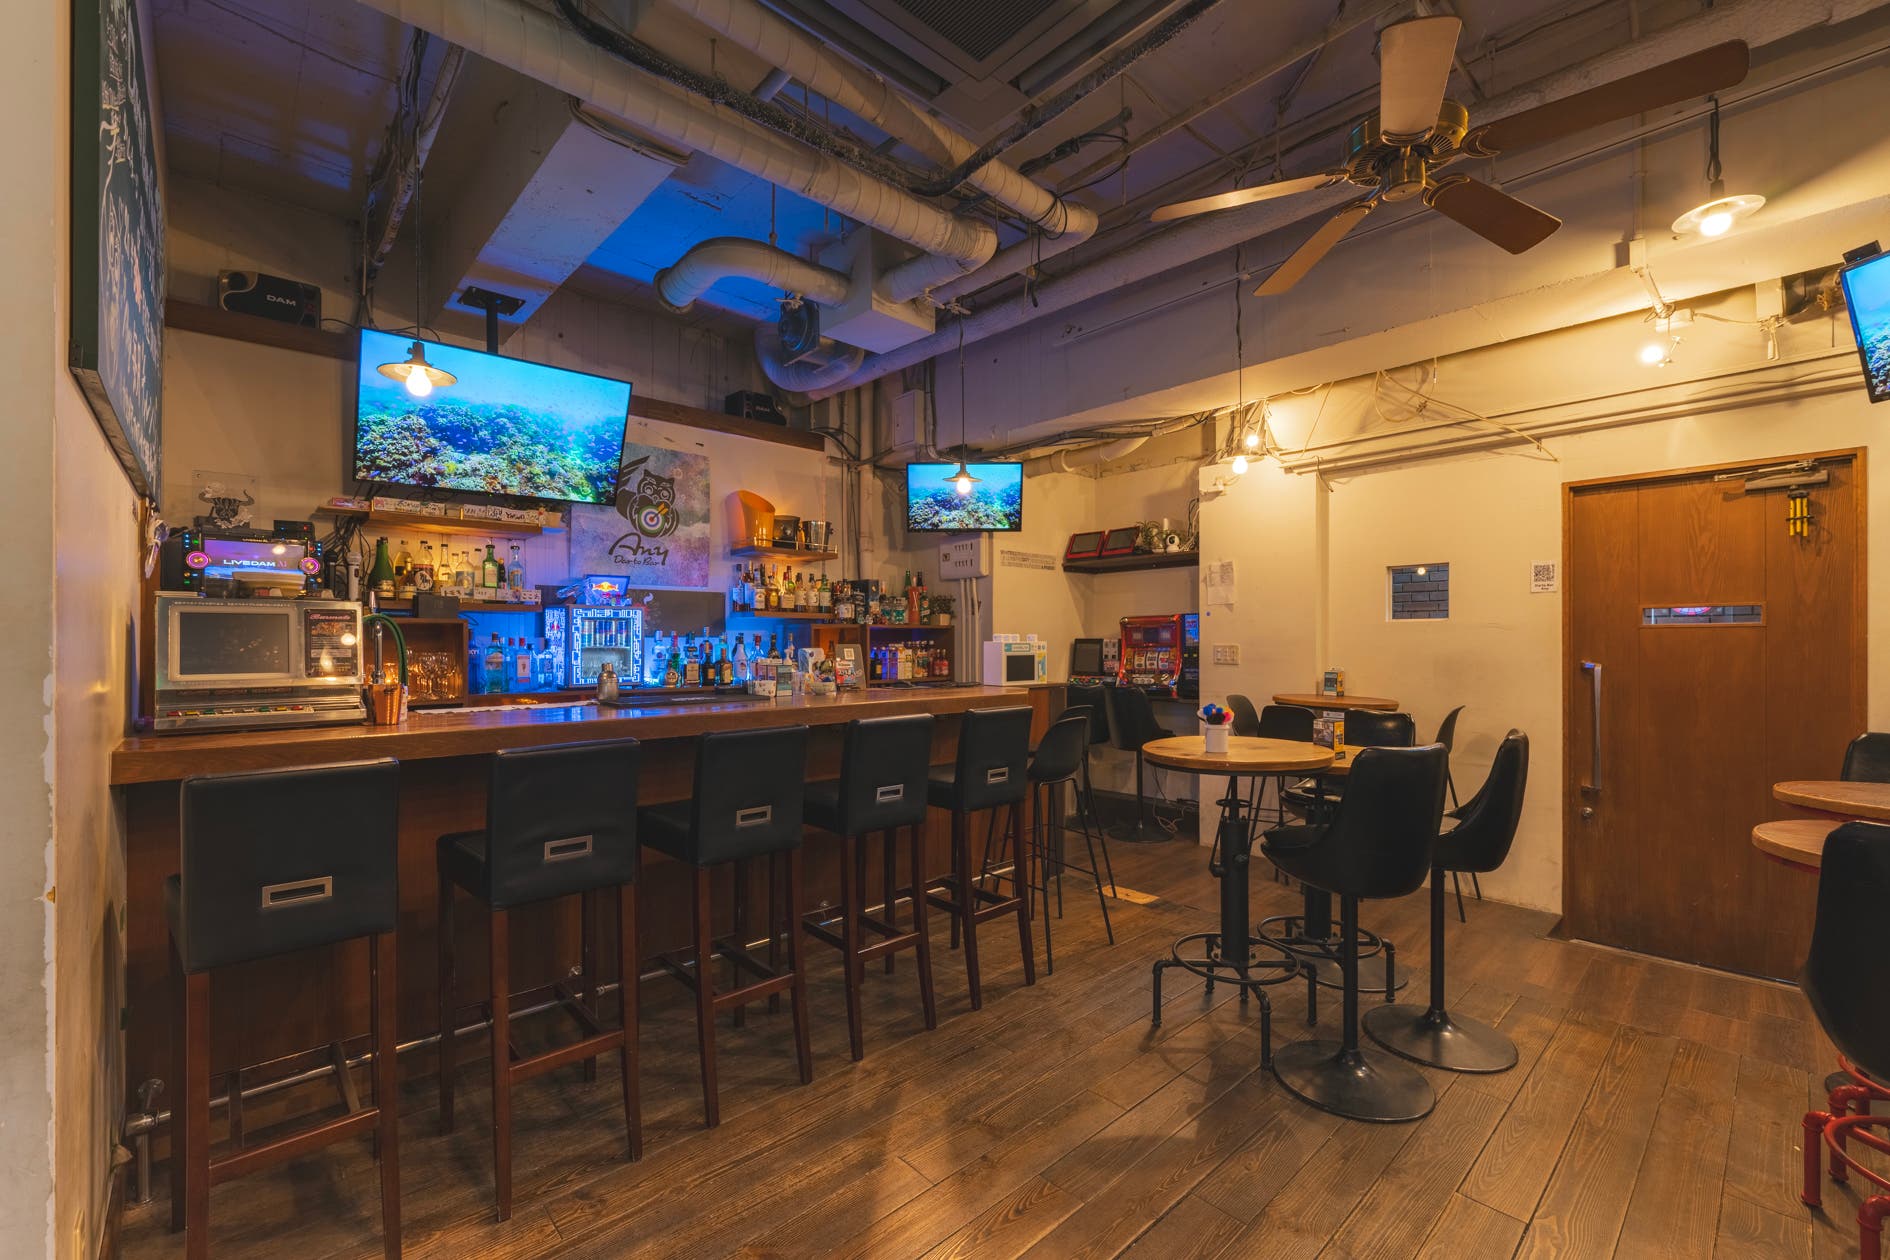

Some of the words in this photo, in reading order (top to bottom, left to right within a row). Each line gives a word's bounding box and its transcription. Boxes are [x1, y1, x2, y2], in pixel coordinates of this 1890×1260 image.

[265, 294, 297, 307] DAM
[607, 532, 669, 566] Any
[223, 559, 276, 568] LIVEDAM
